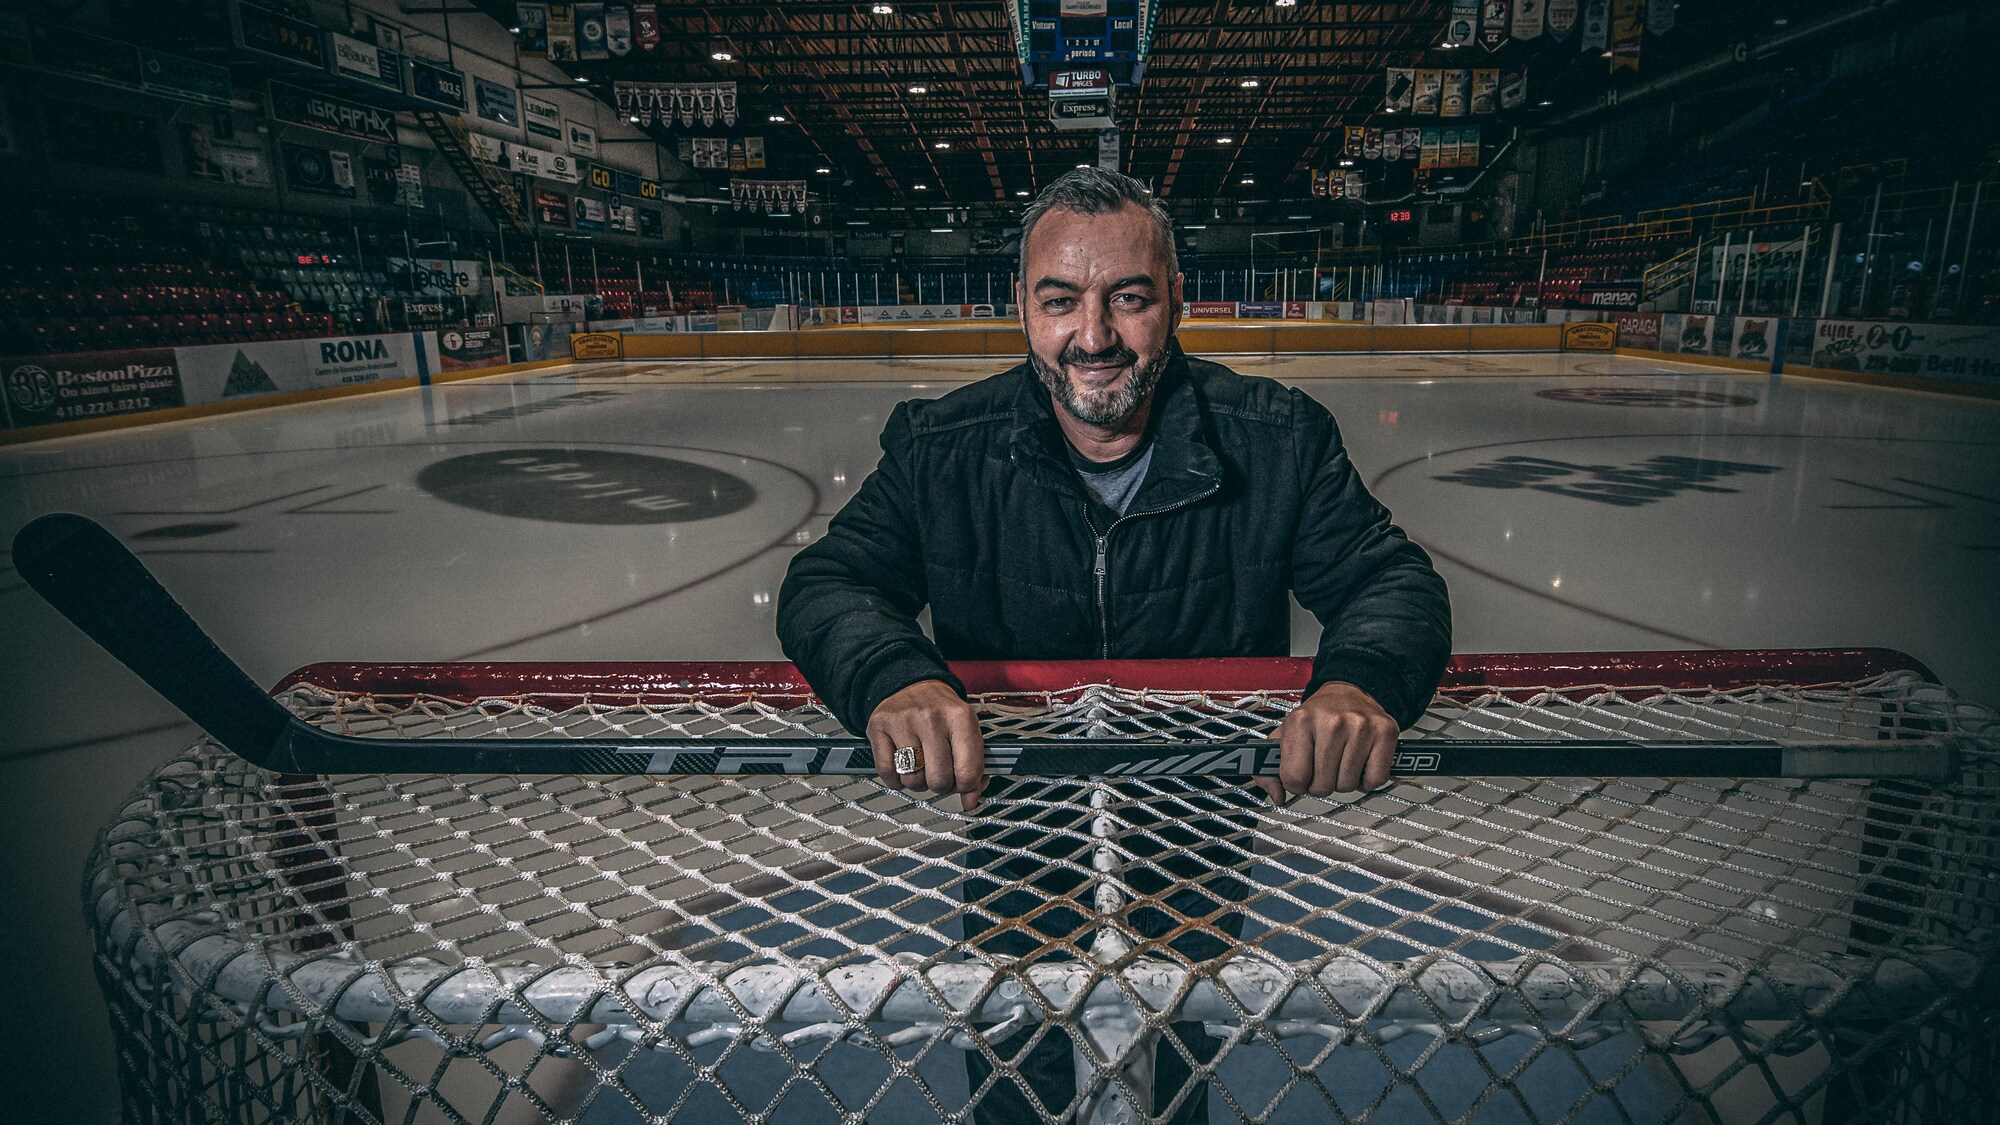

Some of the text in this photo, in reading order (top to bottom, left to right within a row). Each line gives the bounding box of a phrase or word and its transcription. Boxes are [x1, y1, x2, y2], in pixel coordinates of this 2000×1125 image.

[1735, 42, 1748, 62] G
[1071, 70, 1101, 81] TURBO
[1607, 90, 1618, 105] H
[1063, 104, 1096, 114] Express
[592, 167, 609, 189] GO
[640, 180, 657, 199] GO
[946, 213, 955, 223] N
[1215, 208, 1221, 219] L
[1591, 290, 1638, 307] manac
[406, 302, 444, 316] Express
[1192, 306, 1232, 314] UNIVERSEL
[1619, 318, 1658, 335] GARAGA
[320, 338, 389, 364] RONA
[56, 363, 174, 386] Boston Pizza
[60, 387, 79, 398] On
[111, 381, 138, 394] faire
[55, 396, 151, 419] 418.228.8212
